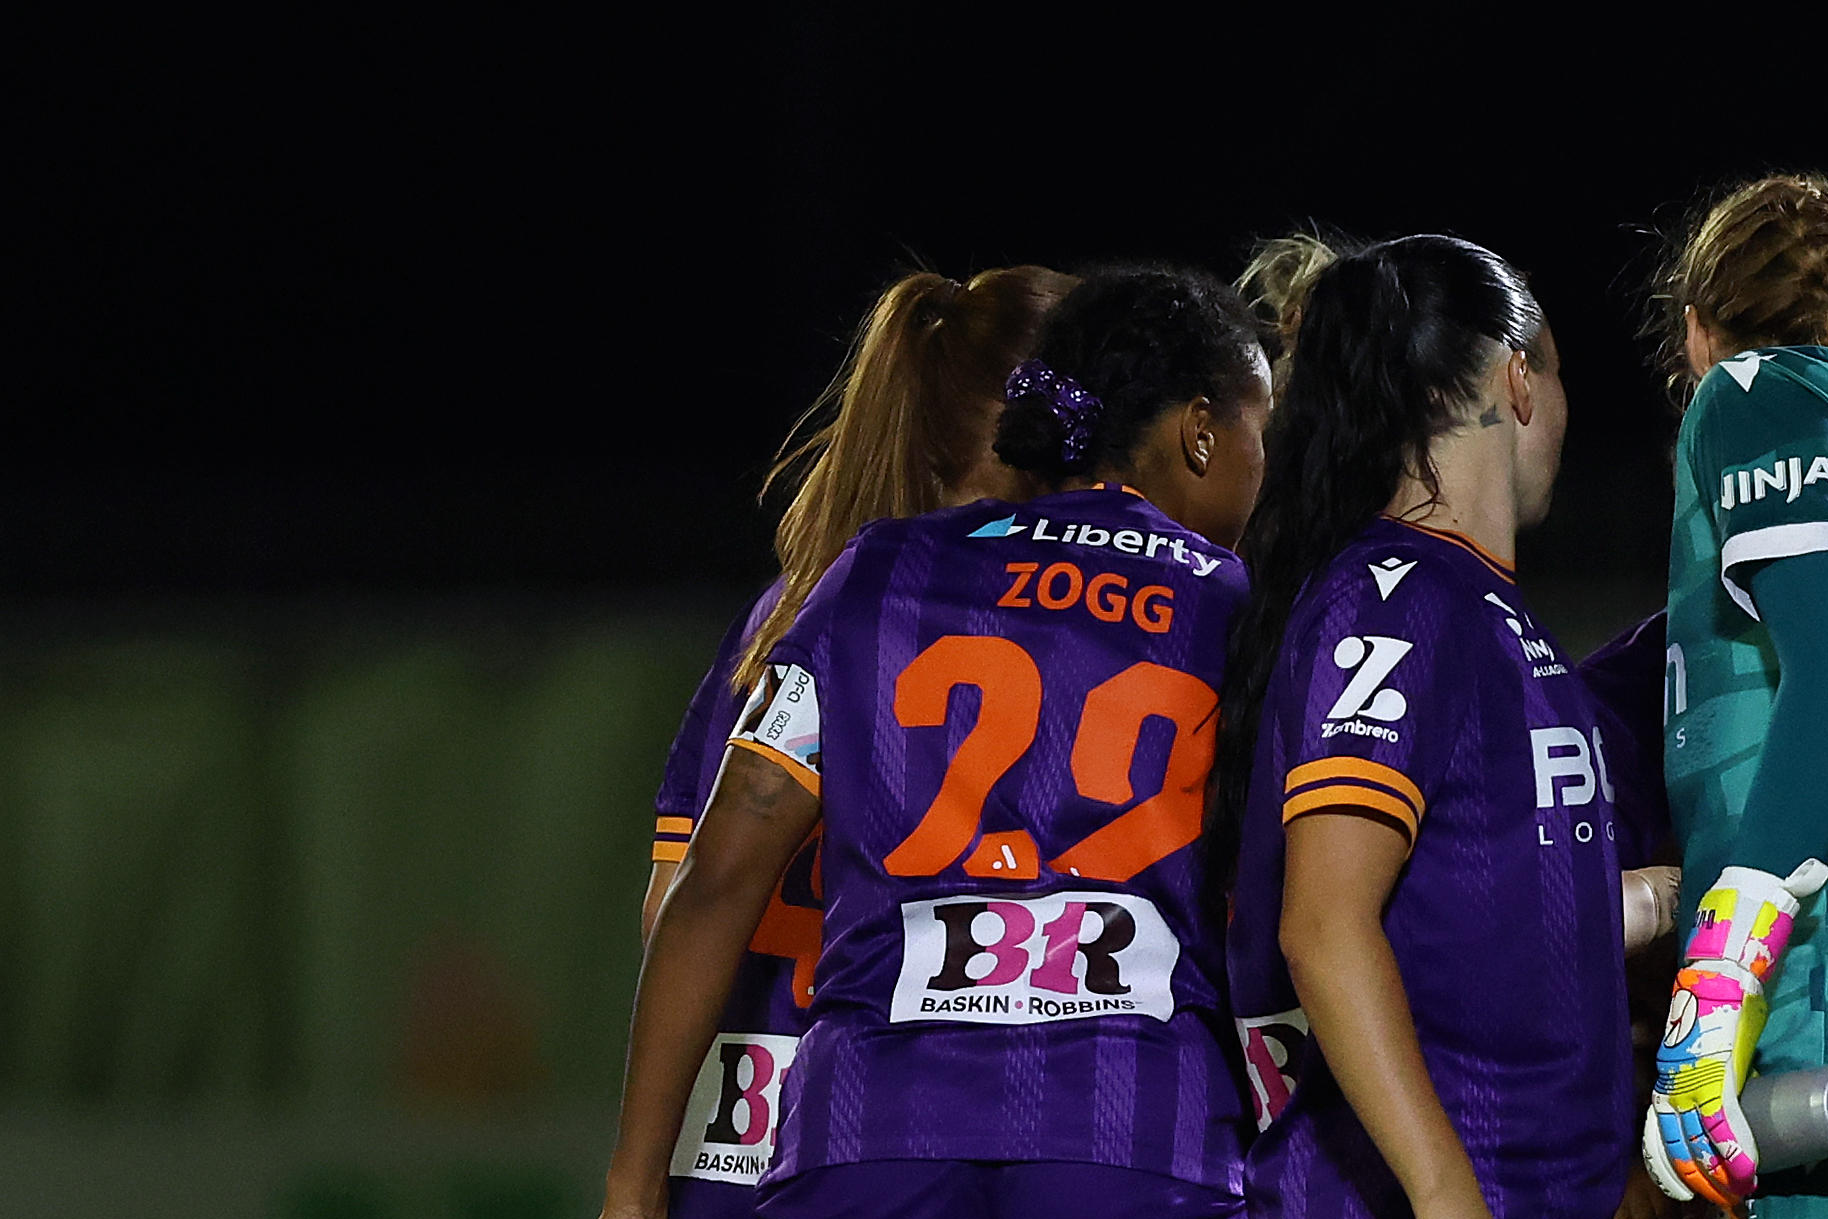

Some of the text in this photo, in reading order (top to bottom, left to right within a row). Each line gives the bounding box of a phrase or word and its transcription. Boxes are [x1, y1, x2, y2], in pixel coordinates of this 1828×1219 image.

[1032, 518, 1222, 577] Liberty
[996, 561, 1175, 634] ZOGG
[926, 901, 1137, 996] BR
[919, 996, 1137, 1016] BASKIN ROBBINS
[694, 1150, 760, 1176] BASKIN
